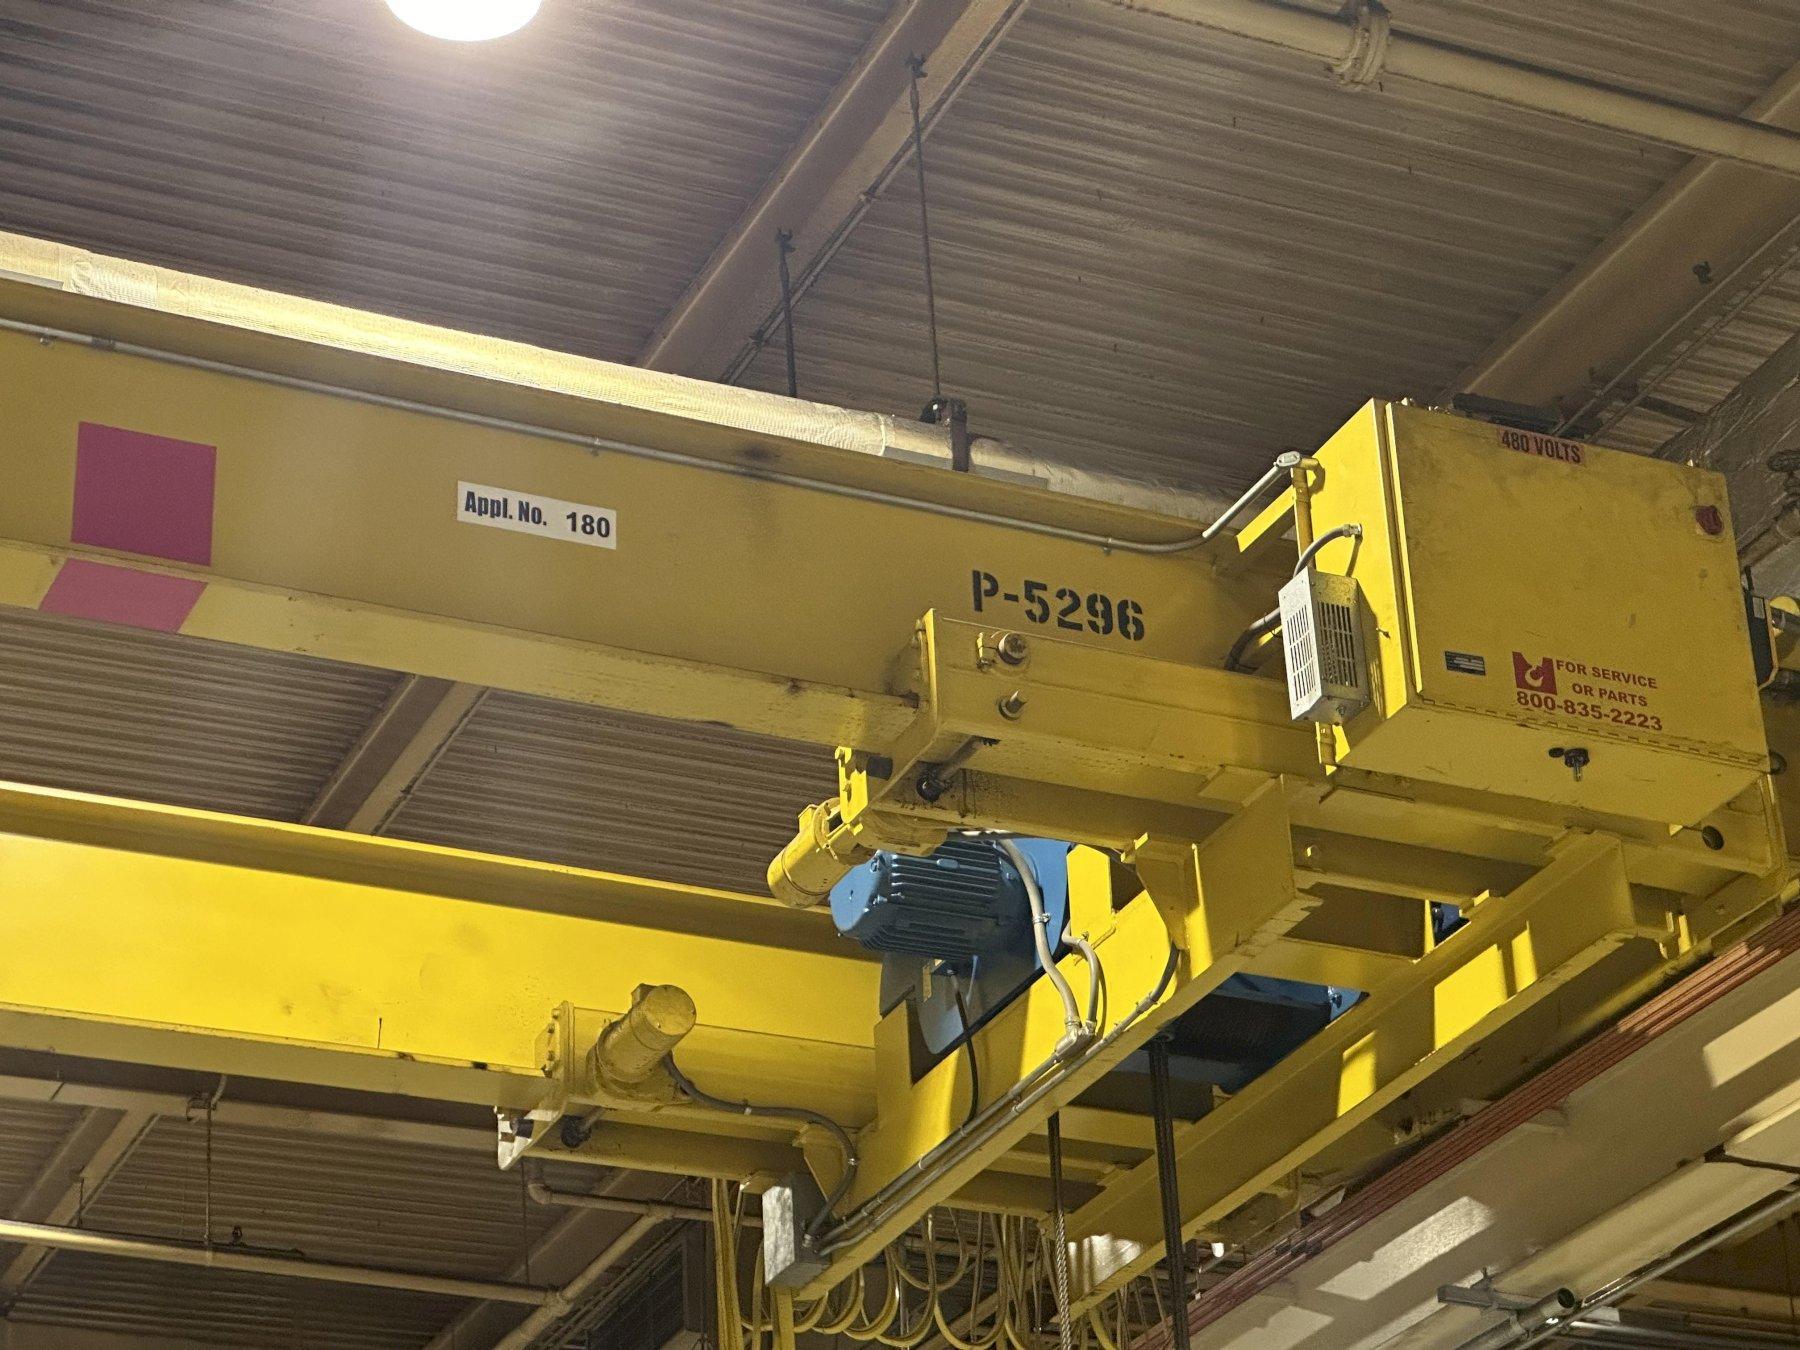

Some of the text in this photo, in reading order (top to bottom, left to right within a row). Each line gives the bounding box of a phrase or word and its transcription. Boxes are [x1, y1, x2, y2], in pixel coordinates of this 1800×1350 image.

[1502, 430, 1581, 463] 480 VOLTS
[464, 490, 611, 538] Appl. No. 180
[972, 569, 1145, 642] P-5296
[1556, 658, 1658, 690] FOR SERVICE
[1516, 691, 1663, 732] 800-835-2223
[1572, 682, 1648, 707] OR PARTS
